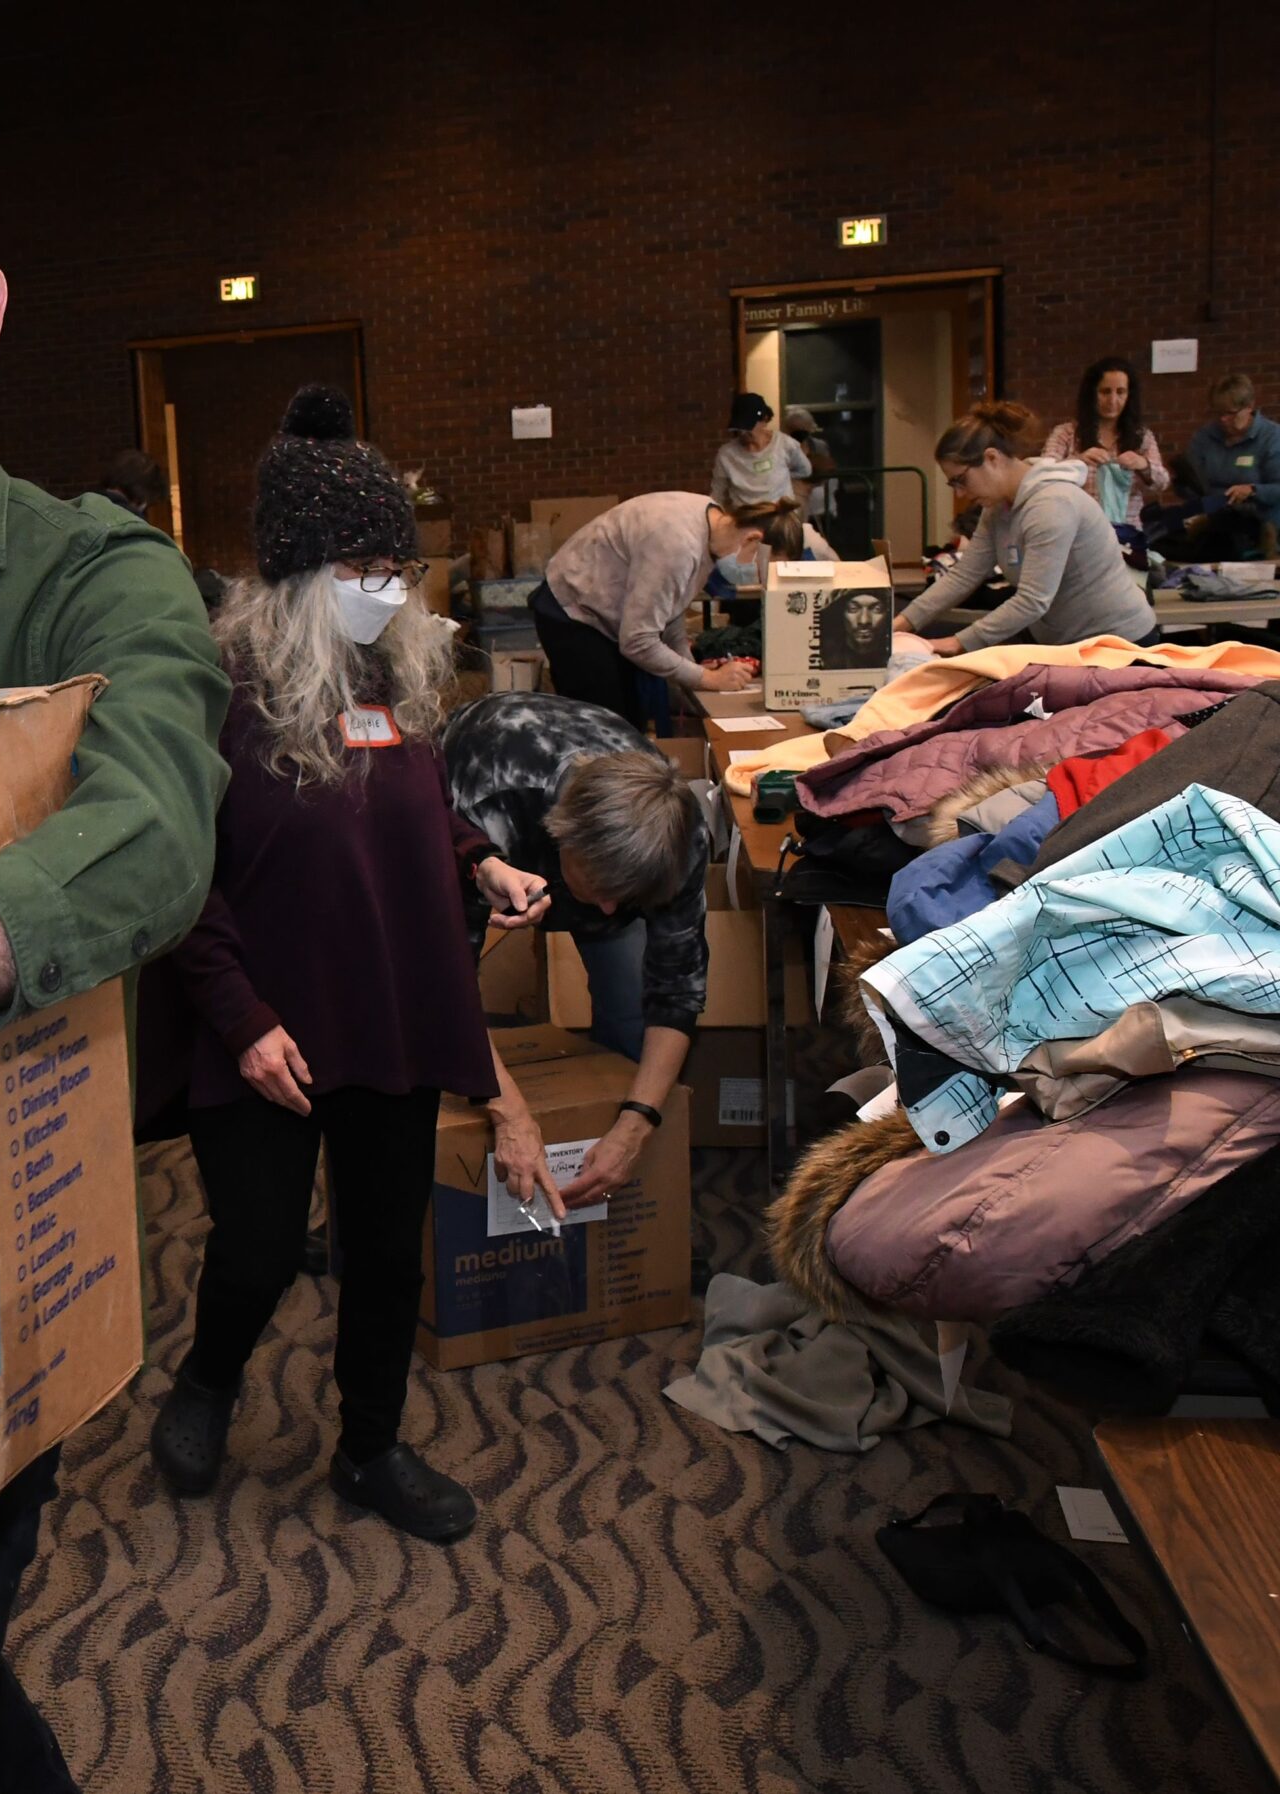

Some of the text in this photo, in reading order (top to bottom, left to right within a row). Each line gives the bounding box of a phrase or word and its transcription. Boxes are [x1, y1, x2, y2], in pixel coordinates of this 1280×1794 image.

[842, 218, 881, 245] EXIT
[221, 276, 255, 301] EXIT
[786, 300, 838, 318] Family
[809, 653, 821, 670] 19
[15, 1015, 68, 1054] Bedroom
[19, 1034, 90, 1088] Family Room
[21, 1065, 91, 1120] Dining Room
[24, 1112, 68, 1151] Kitchen
[26, 1150, 54, 1182] Bath
[549, 1148, 584, 1158] INVENTORY
[28, 1160, 83, 1213] Basement
[29, 1212, 58, 1244] Attic
[31, 1228, 77, 1274] Laundry
[455, 1238, 565, 1273] medium
[32, 1261, 74, 1303] Garage
[32, 1254, 116, 1335] A Load of Bricks
